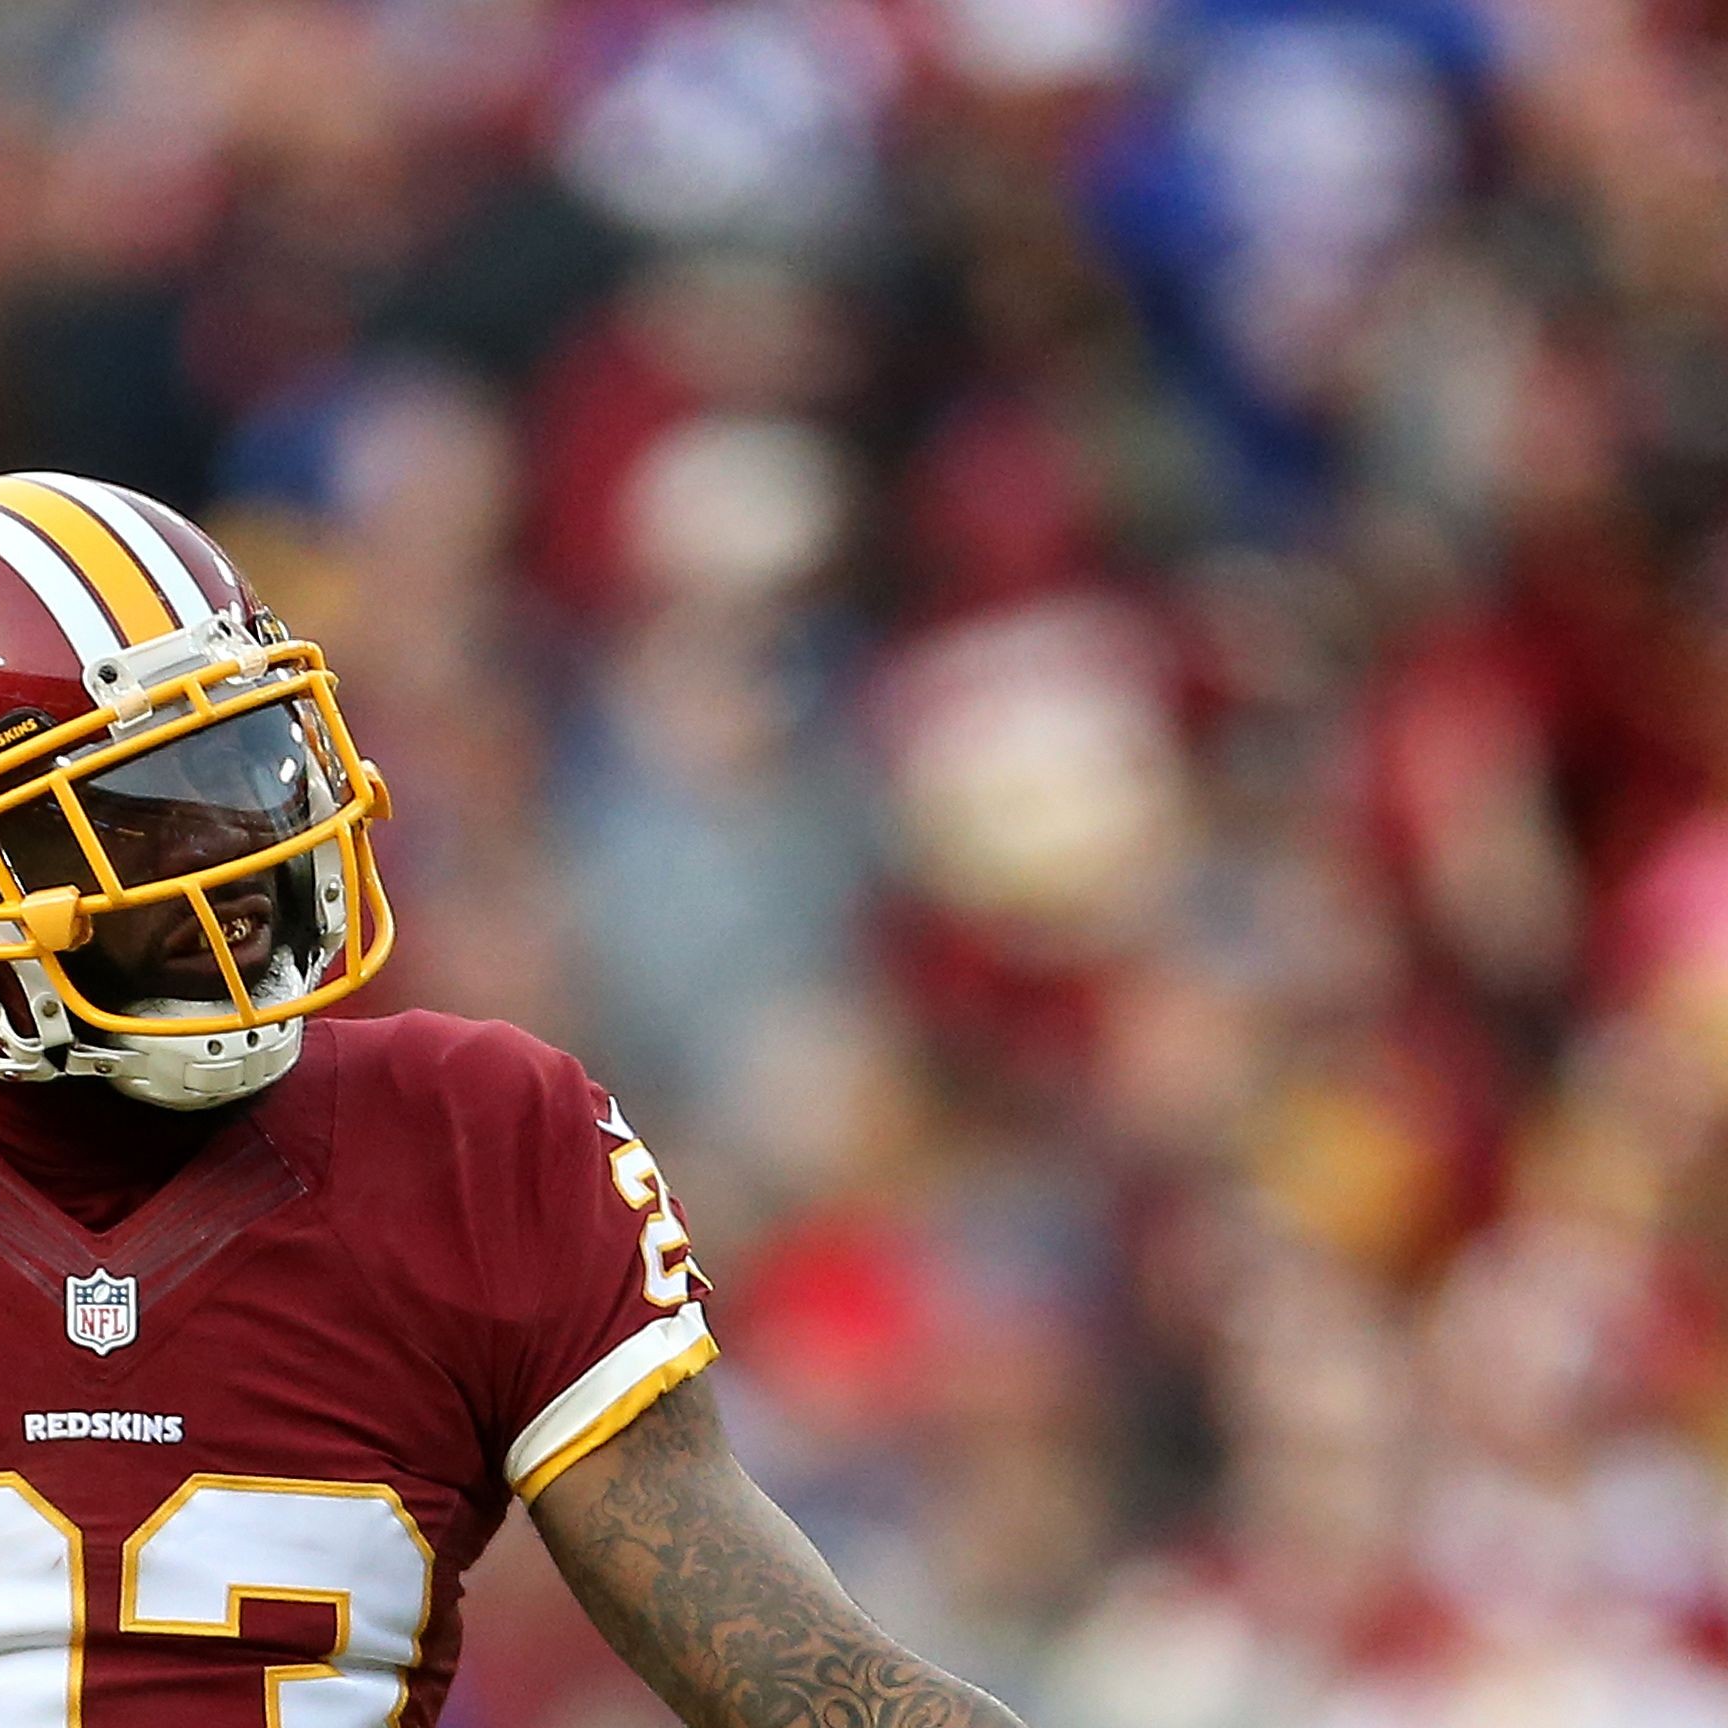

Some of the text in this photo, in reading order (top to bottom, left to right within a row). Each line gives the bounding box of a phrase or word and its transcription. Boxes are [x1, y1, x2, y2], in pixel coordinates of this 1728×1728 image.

[608, 1136, 715, 1309] 2
[80, 1308, 125, 1340] NFL
[23, 1411, 184, 1443] REDSKINS
